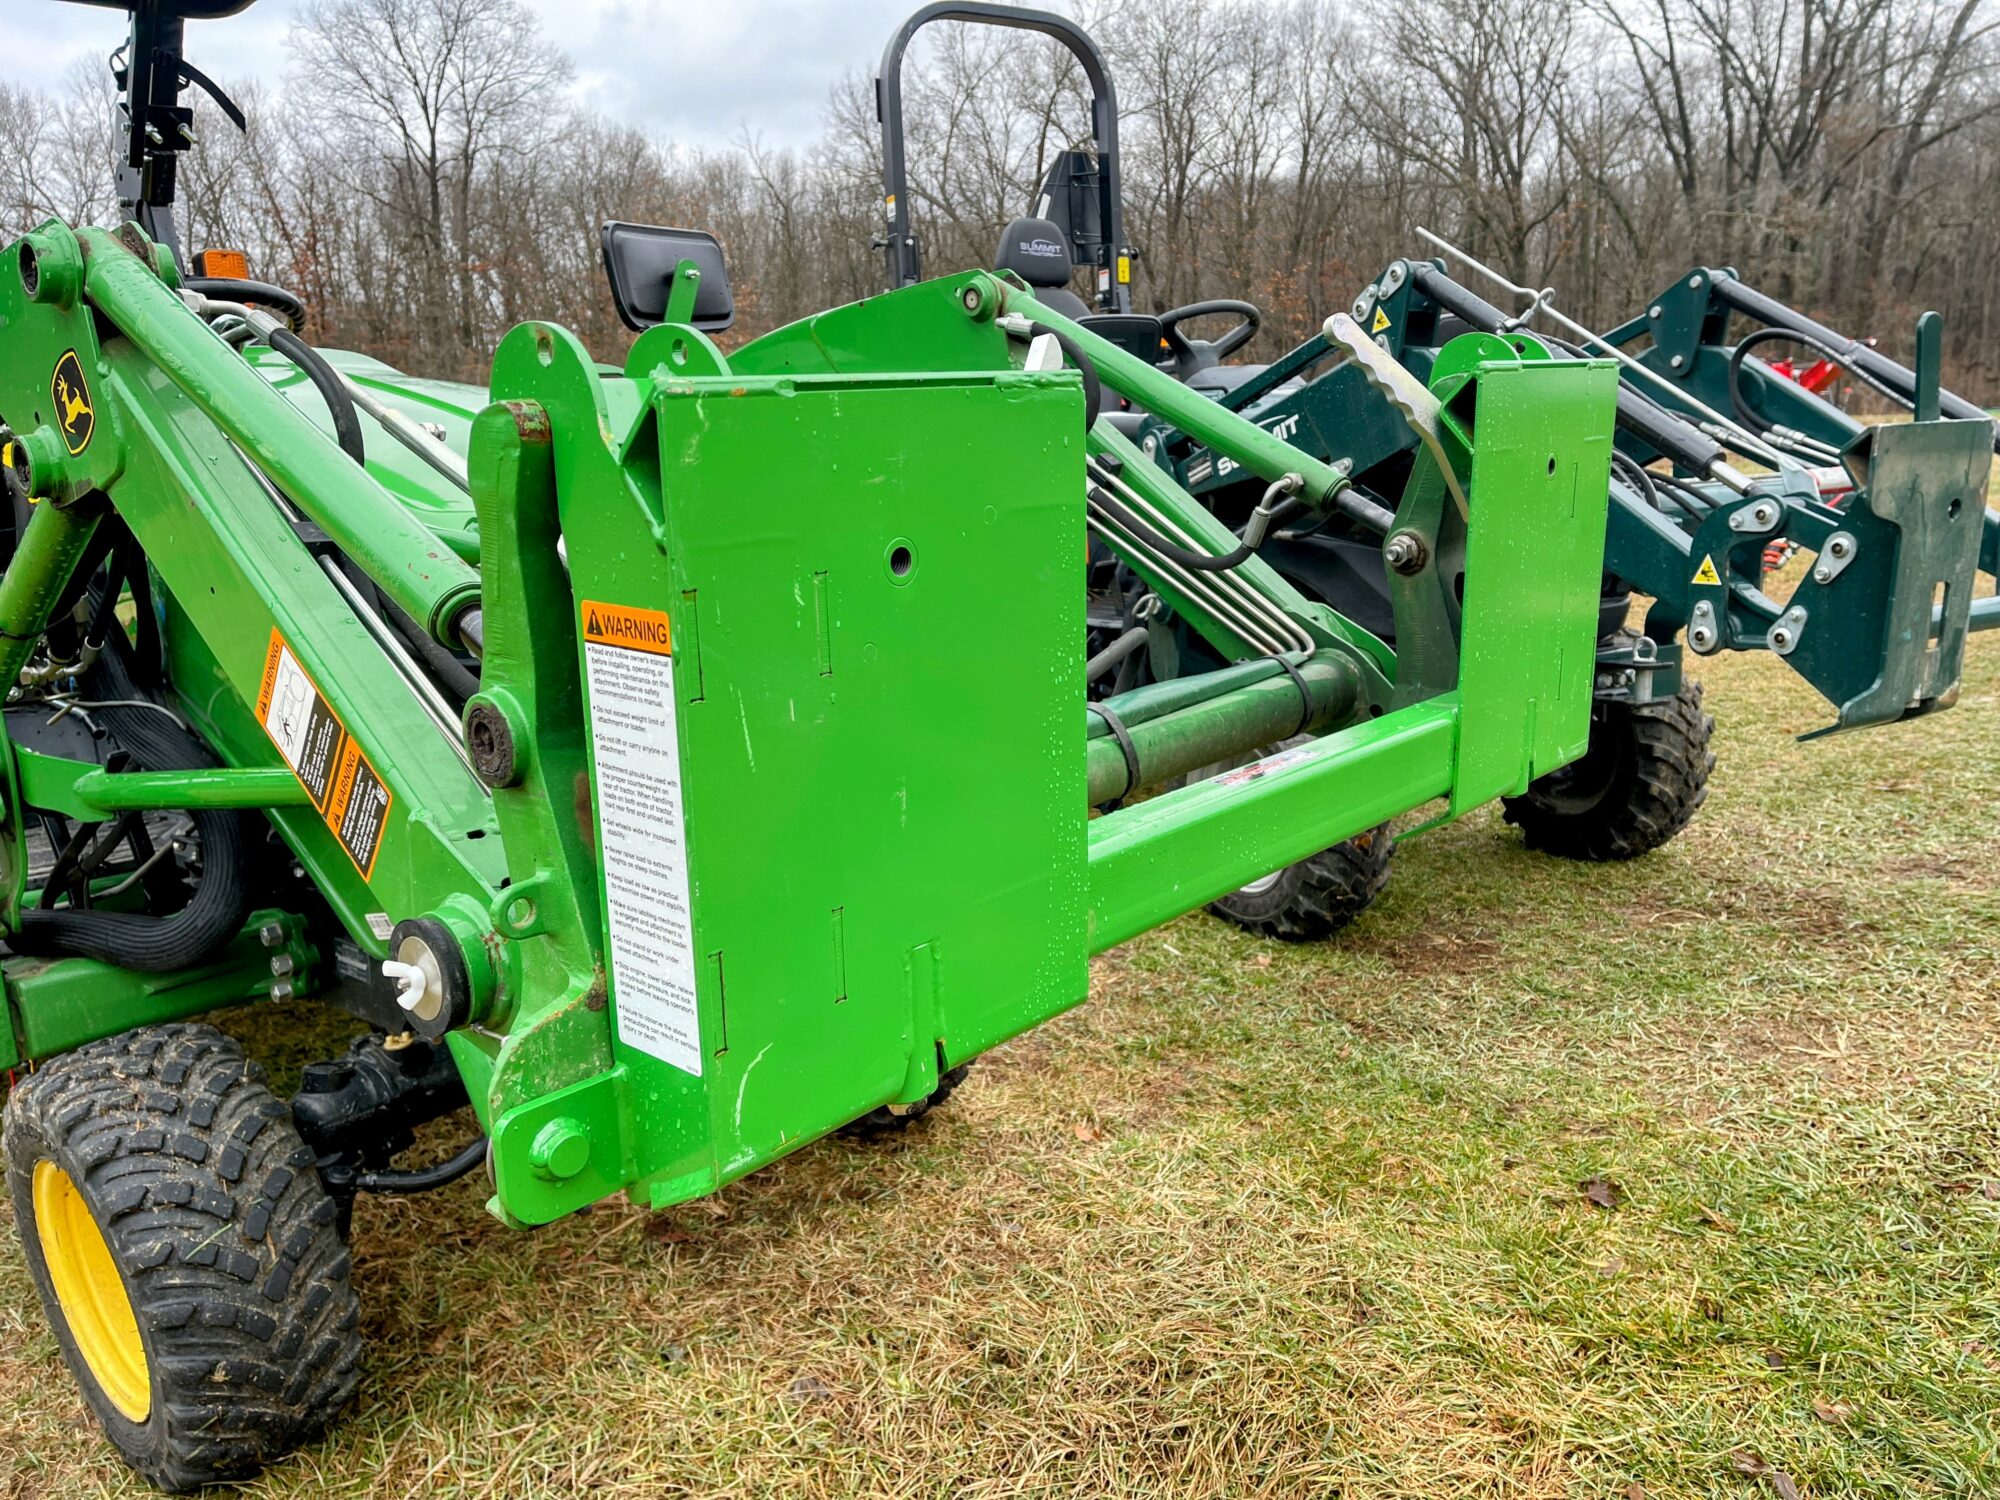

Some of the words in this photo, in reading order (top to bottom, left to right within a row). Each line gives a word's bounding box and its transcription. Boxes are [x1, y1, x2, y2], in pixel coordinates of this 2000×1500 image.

[1020, 241, 1061, 253] SUMMIT
[602, 614, 667, 644] WARNING
[591, 657, 607, 665] before
[615, 651, 628, 659] follow
[650, 658, 668, 667] manual
[262, 642, 279, 699] WARNING
[593, 667, 618, 679] performing
[619, 673, 650, 684] maintenance
[594, 688, 636, 701] recommendations
[622, 683, 642, 692] Observe
[644, 688, 659, 697] safety
[597, 716, 623, 726] attachment
[613, 710, 629, 718] exceed
[631, 714, 646, 724] weight
[648, 717, 658, 725] limit
[628, 742, 641, 751] carry
[642, 745, 660, 756] anyone
[336, 751, 356, 808] WARNING
[601, 761, 627, 774] Attachment
[629, 769, 645, 779] should
[654, 776, 665, 784] used
[610, 774, 626, 784] proper
[627, 779, 660, 794] counterweight
[604, 791, 616, 800] loads
[625, 797, 635, 805] both
[636, 800, 648, 809] ends
[637, 790, 651, 800] When
[652, 795, 673, 808] handling
[604, 800, 614, 808] load
[647, 813, 663, 823] unload
[615, 821, 631, 831] wheels
[632, 827, 643, 835] wide
[652, 832, 676, 845] increased
[609, 846, 622, 855] Never
[623, 851, 634, 859] raise
[635, 854, 646, 863] load
[653, 860, 672, 871] extreme
[634, 864, 647, 874] steep
[611, 872, 622, 882] Keep
[624, 877, 633, 885] load
[658, 889, 678, 901] practical
[617, 884, 639, 896] maximize
[640, 893, 654, 903] power
[656, 897, 665, 905] unit
